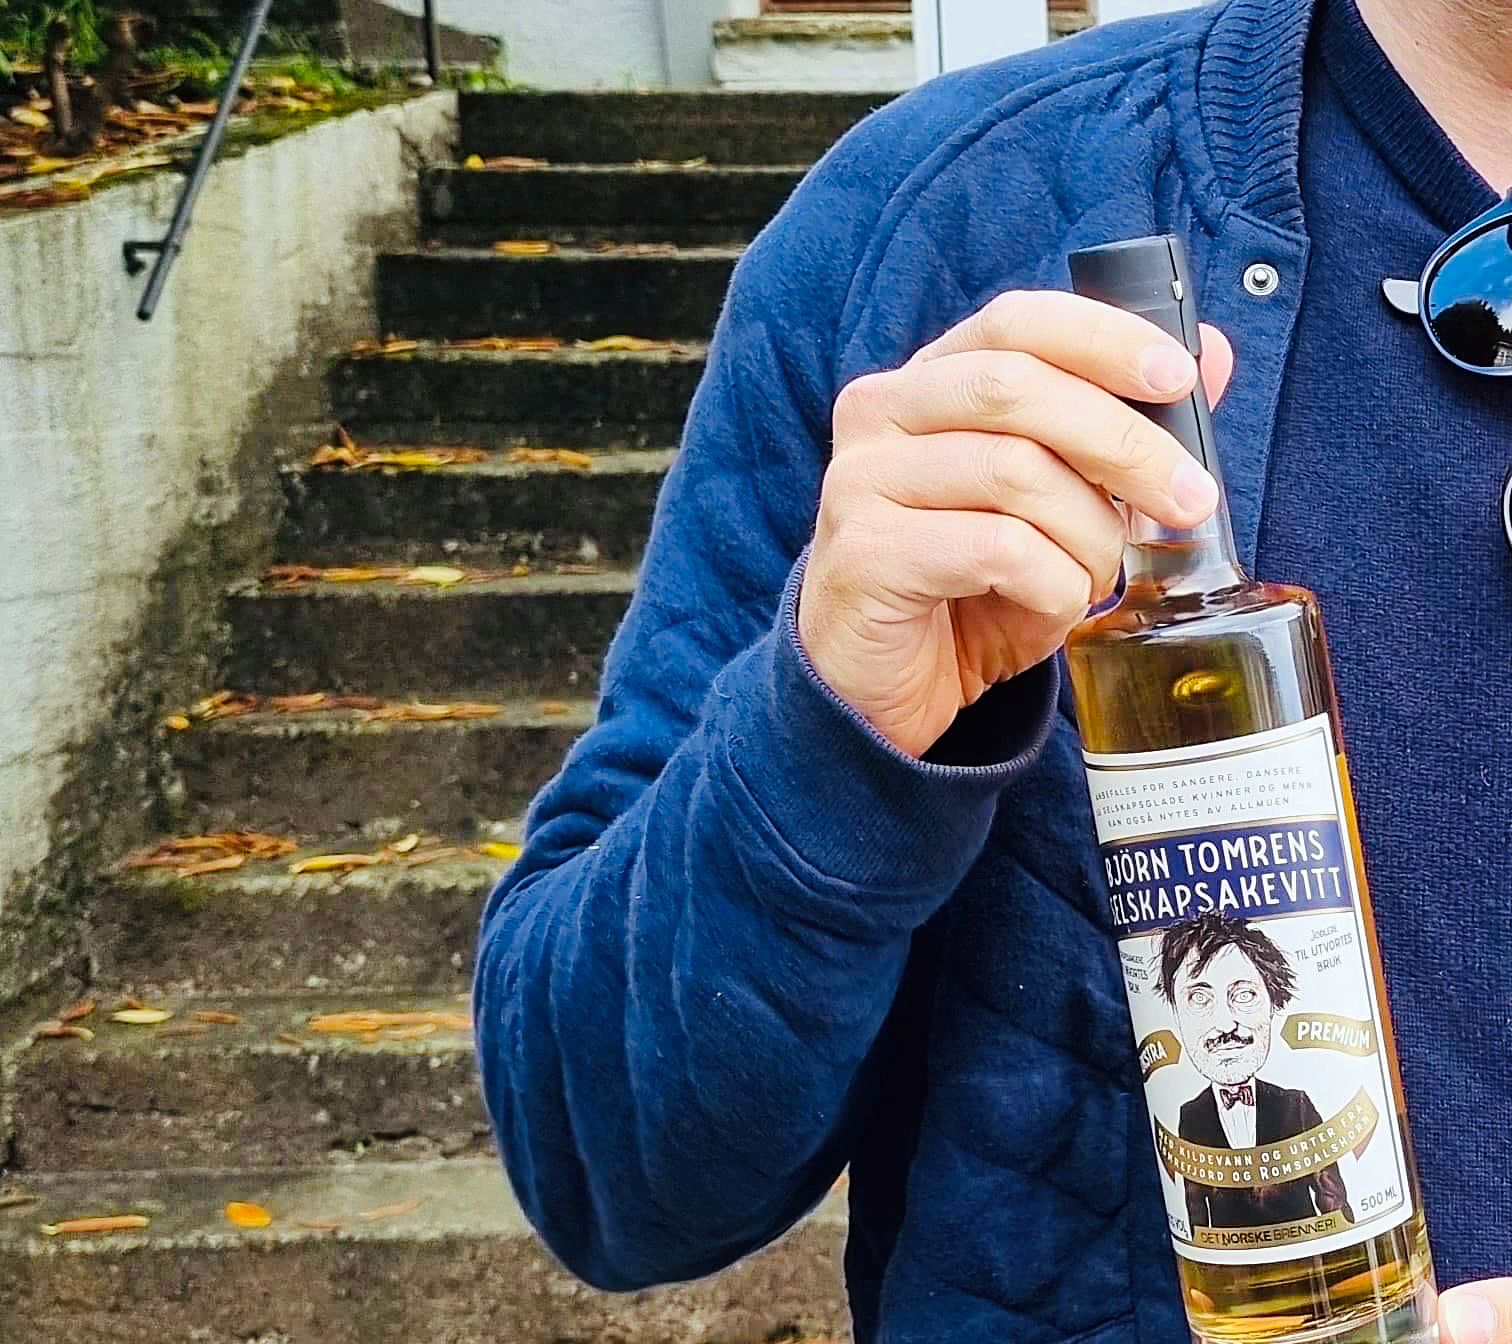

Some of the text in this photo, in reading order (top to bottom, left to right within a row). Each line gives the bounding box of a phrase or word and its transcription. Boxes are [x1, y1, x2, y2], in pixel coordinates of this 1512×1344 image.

[1142, 782, 1165, 792] FOR
[1246, 766, 1303, 779] DANSERE
[1192, 786, 1252, 802] KVINNER
[1259, 783, 1276, 793] OG
[1160, 808, 1199, 821] NYTES
[1207, 805, 1222, 815] AV
[1105, 829, 1325, 888] BJÖRN TOMRENS
[1295, 949, 1310, 961] TIL
[1316, 954, 1341, 972] BRUK
[1296, 1021, 1371, 1050] PREMIUM
[1179, 1146, 1253, 1167] KILDEVANN
[1261, 1150, 1281, 1163] OG
[1290, 1127, 1337, 1156] URTER
[1340, 1103, 1363, 1130] FRA
[1232, 1170, 1252, 1182] OG
[1259, 1116, 1372, 1182] ROMSDALSHORN
[1359, 1186, 1398, 1212] 500 ML
[1221, 1230, 1273, 1246] NORSKE
